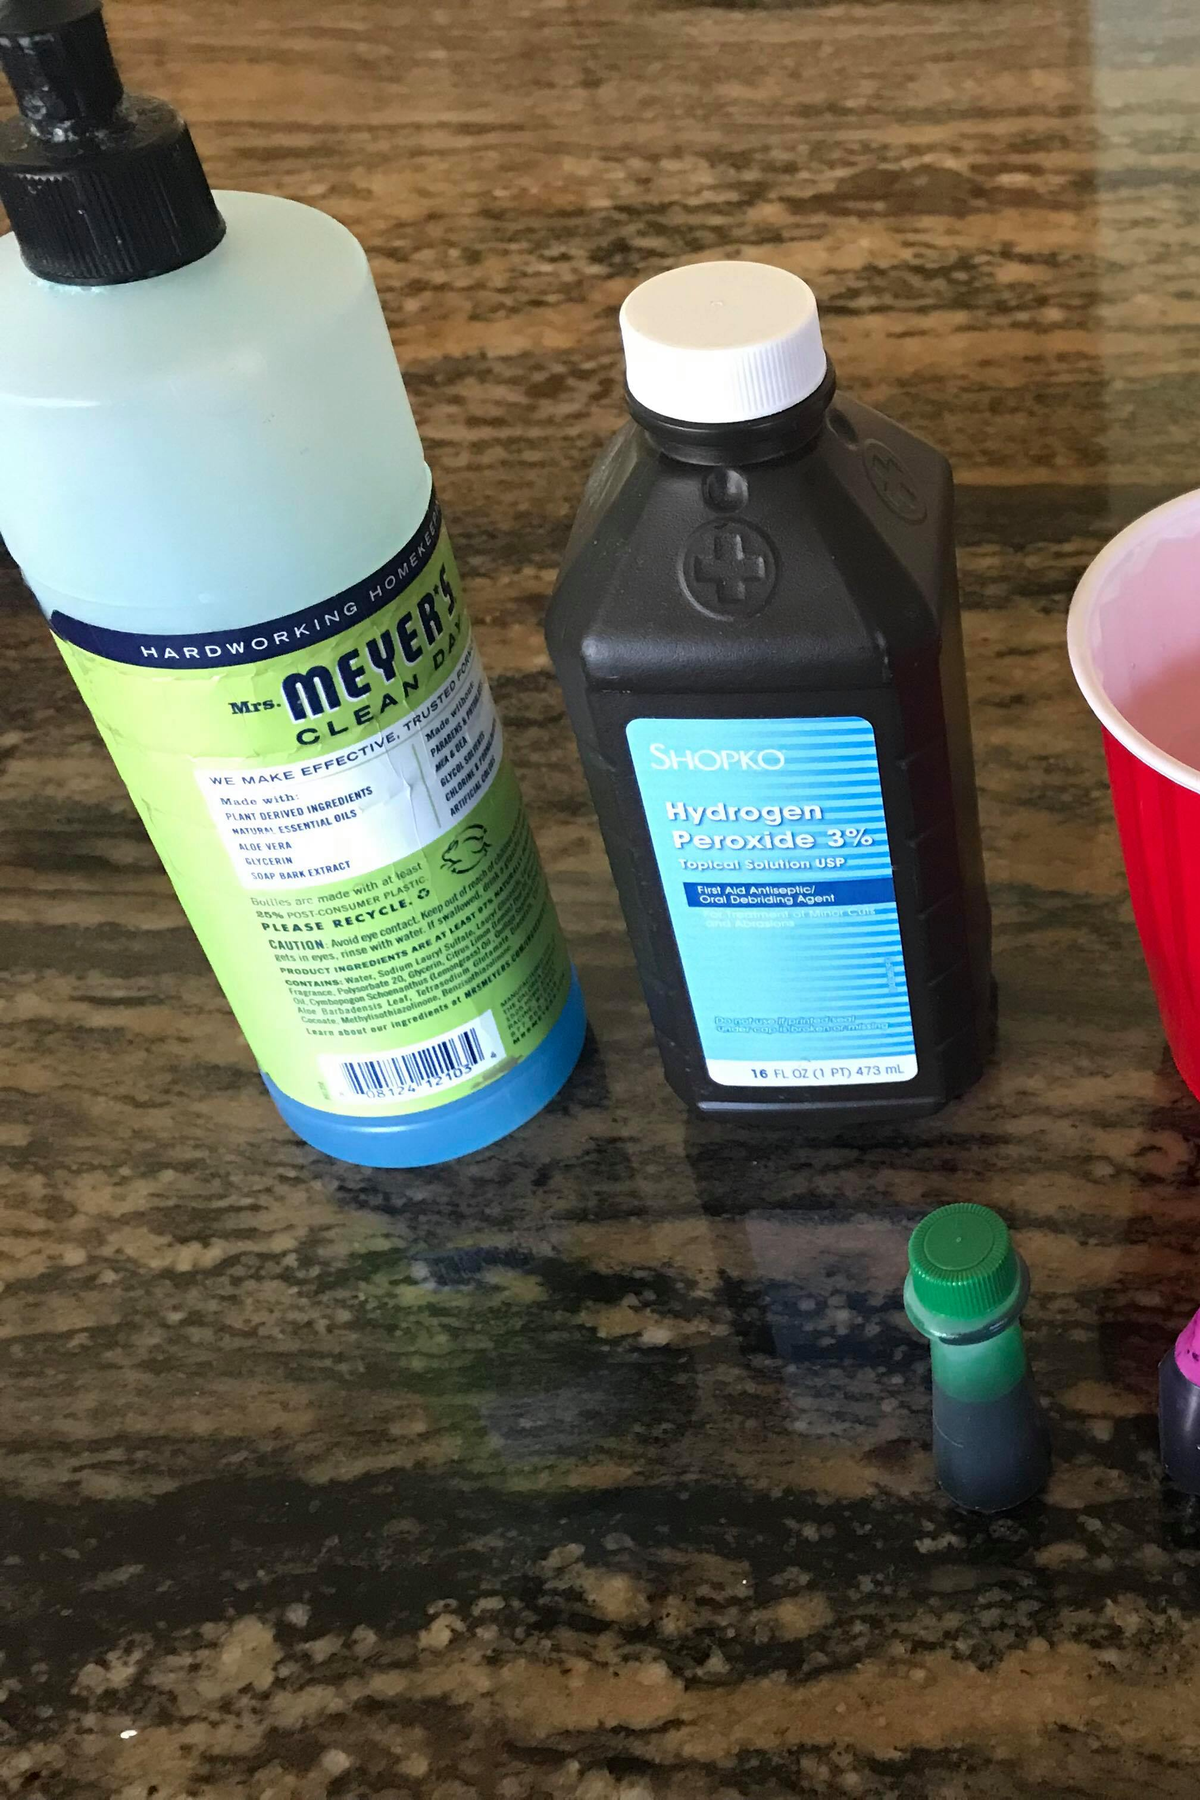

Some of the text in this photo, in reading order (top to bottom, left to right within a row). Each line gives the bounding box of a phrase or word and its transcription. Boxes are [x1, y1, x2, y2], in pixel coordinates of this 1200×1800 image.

[140, 503, 439, 659] HARDWORKING HOMEKEEP
[228, 699, 281, 715] Mrs.
[281, 562, 456, 724] MEYER'S
[296, 673, 420, 746] CLEAN
[433, 614, 461, 671] DAY
[209, 776, 236, 786] WE
[241, 770, 296, 786] MAKE
[301, 732, 401, 777] EFFECTIVE,
[403, 680, 456, 731] TRUSTED
[425, 717, 450, 743] Made
[430, 721, 463, 758] PARABENS
[435, 755, 450, 773] MEA
[649, 743, 785, 771] SHOPKO
[440, 763, 464, 788] GLYCOL
[445, 769, 476, 802] CHLORINE
[220, 793, 300, 806] Made with:
[225, 786, 373, 821] PLANT DERIVED INGREDIENTS
[450, 782, 482, 817] ARTIFICIAL
[232, 809, 358, 835] NATURAL ESSENTIAL OILS
[666, 801, 823, 826] Hydrogen
[238, 841, 292, 851] ALOE VERA
[672, 827, 874, 850] Peroxide 3%
[245, 856, 293, 866] GLYCERIN
[251, 860, 351, 880] SOAP BARK EXTRACT
[678, 857, 846, 871] Topical Solution USP
[317, 889, 350, 904] made
[352, 880, 378, 896] with
[382, 875, 393, 886] at
[395, 862, 423, 881] least
[697, 885, 816, 898] First Aid Antiseptic/
[268, 938, 329, 951] CAUTION:
[331, 934, 359, 948] Avoid
[361, 931, 379, 943] eye
[380, 918, 421, 937] contact.
[421, 903, 444, 921] Keep
[445, 891, 459, 908] out
[459, 885, 468, 898] of
[468, 869, 488, 893] reach
[287, 895, 381, 919] POST-CONSUMER
[699, 894, 835, 905] Oral Debriding Agent
[809, 908, 844, 917] Minor
[261, 898, 413, 932] PLEASE RECYCLE.
[274, 953, 296, 963] gets
[299, 952, 309, 962] in
[311, 951, 339, 962] eyes,
[341, 946, 368, 959] rinse
[369, 940, 393, 952] with
[394, 928, 426, 945] water.
[279, 910, 476, 975] PRODUCT INGREDIENTS ARE AT LEAST
[285, 979, 343, 987] CONTAINS:
[344, 973, 376, 985] Water,
[377, 961, 413, 978] Sodium
[415, 947, 443, 965] Lauryl
[337, 979, 390, 996] Polysorbate
[306, 996, 462, 1036] Learn about our ingredients at
[321, 1001, 382, 1015] Barbadensis
[790, 1024, 831, 1033] broken
[366, 1063, 473, 1099] 08124 12103
[751, 1063, 905, 1080] 16 FL OZ (1 PT) 473 mL
